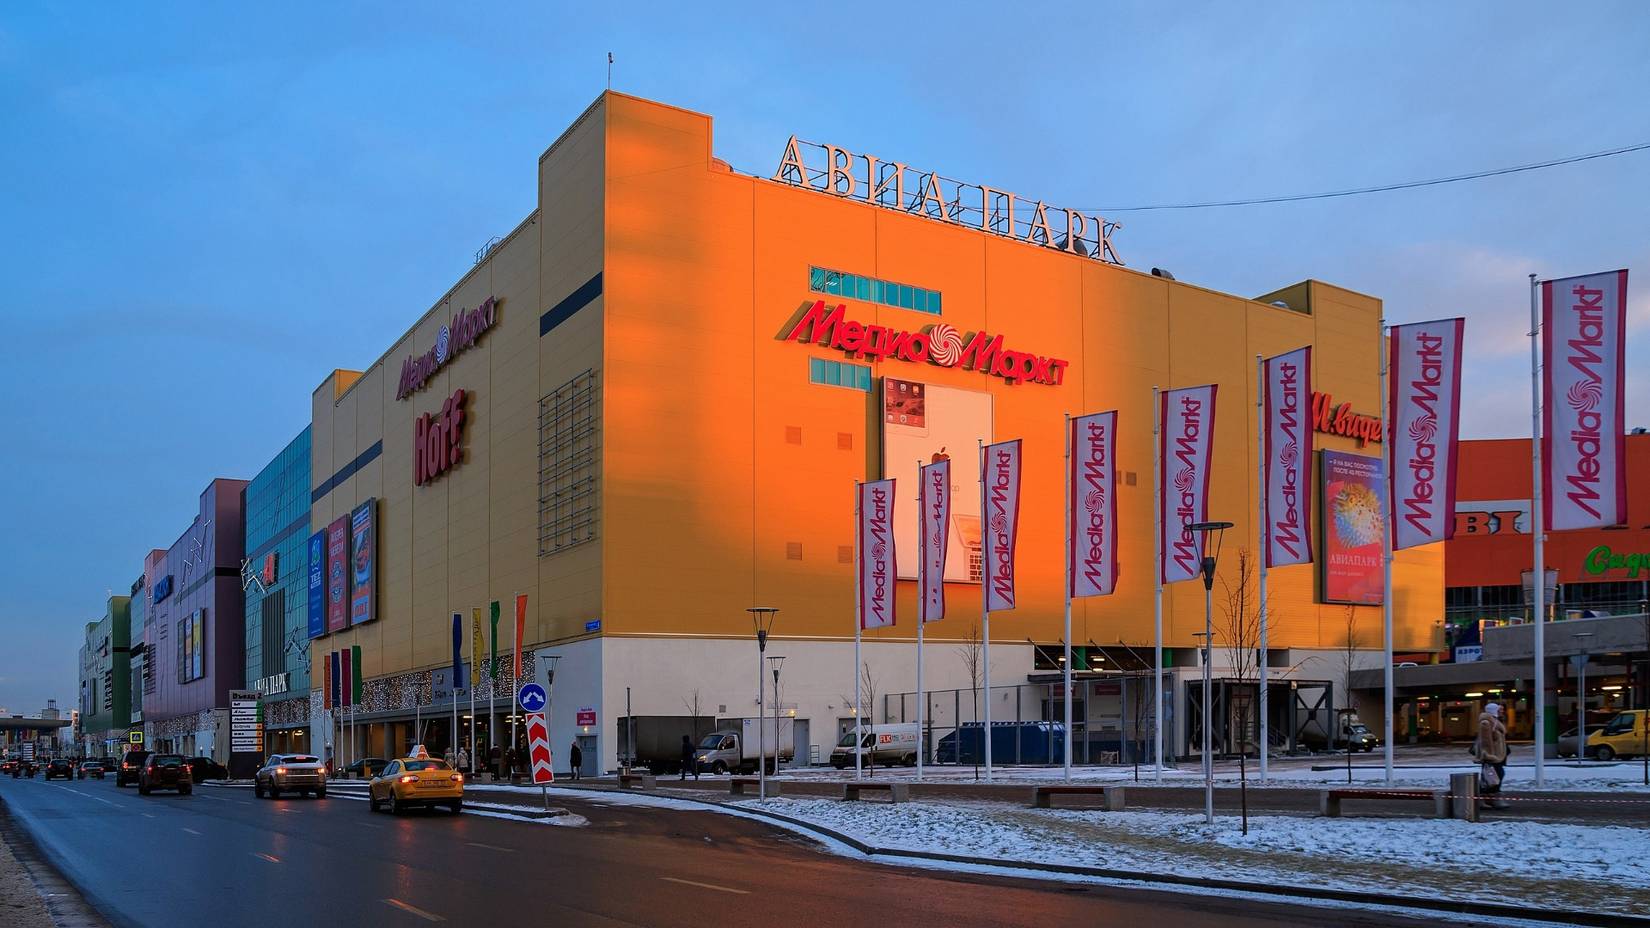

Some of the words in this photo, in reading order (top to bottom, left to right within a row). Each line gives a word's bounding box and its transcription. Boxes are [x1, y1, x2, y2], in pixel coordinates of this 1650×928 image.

[770, 134, 954, 224] АВИА
[978, 184, 1126, 266] ПАРК
[788, 299, 931, 364] Медиа
[957, 330, 1070, 386] Маркт
[1567, 284, 1604, 385] Markt
[1279, 361, 1297, 445] Markt
[1411, 332, 1443, 420] Markt
[1084, 422, 1105, 494] Markt
[1175, 396, 1201, 471] Markt
[870, 487, 887, 545] Markt
[991, 450, 1012, 516] Markt
[1330, 553, 1377, 567] АВИАПАРК
[1453, 511, 1522, 536] BI
